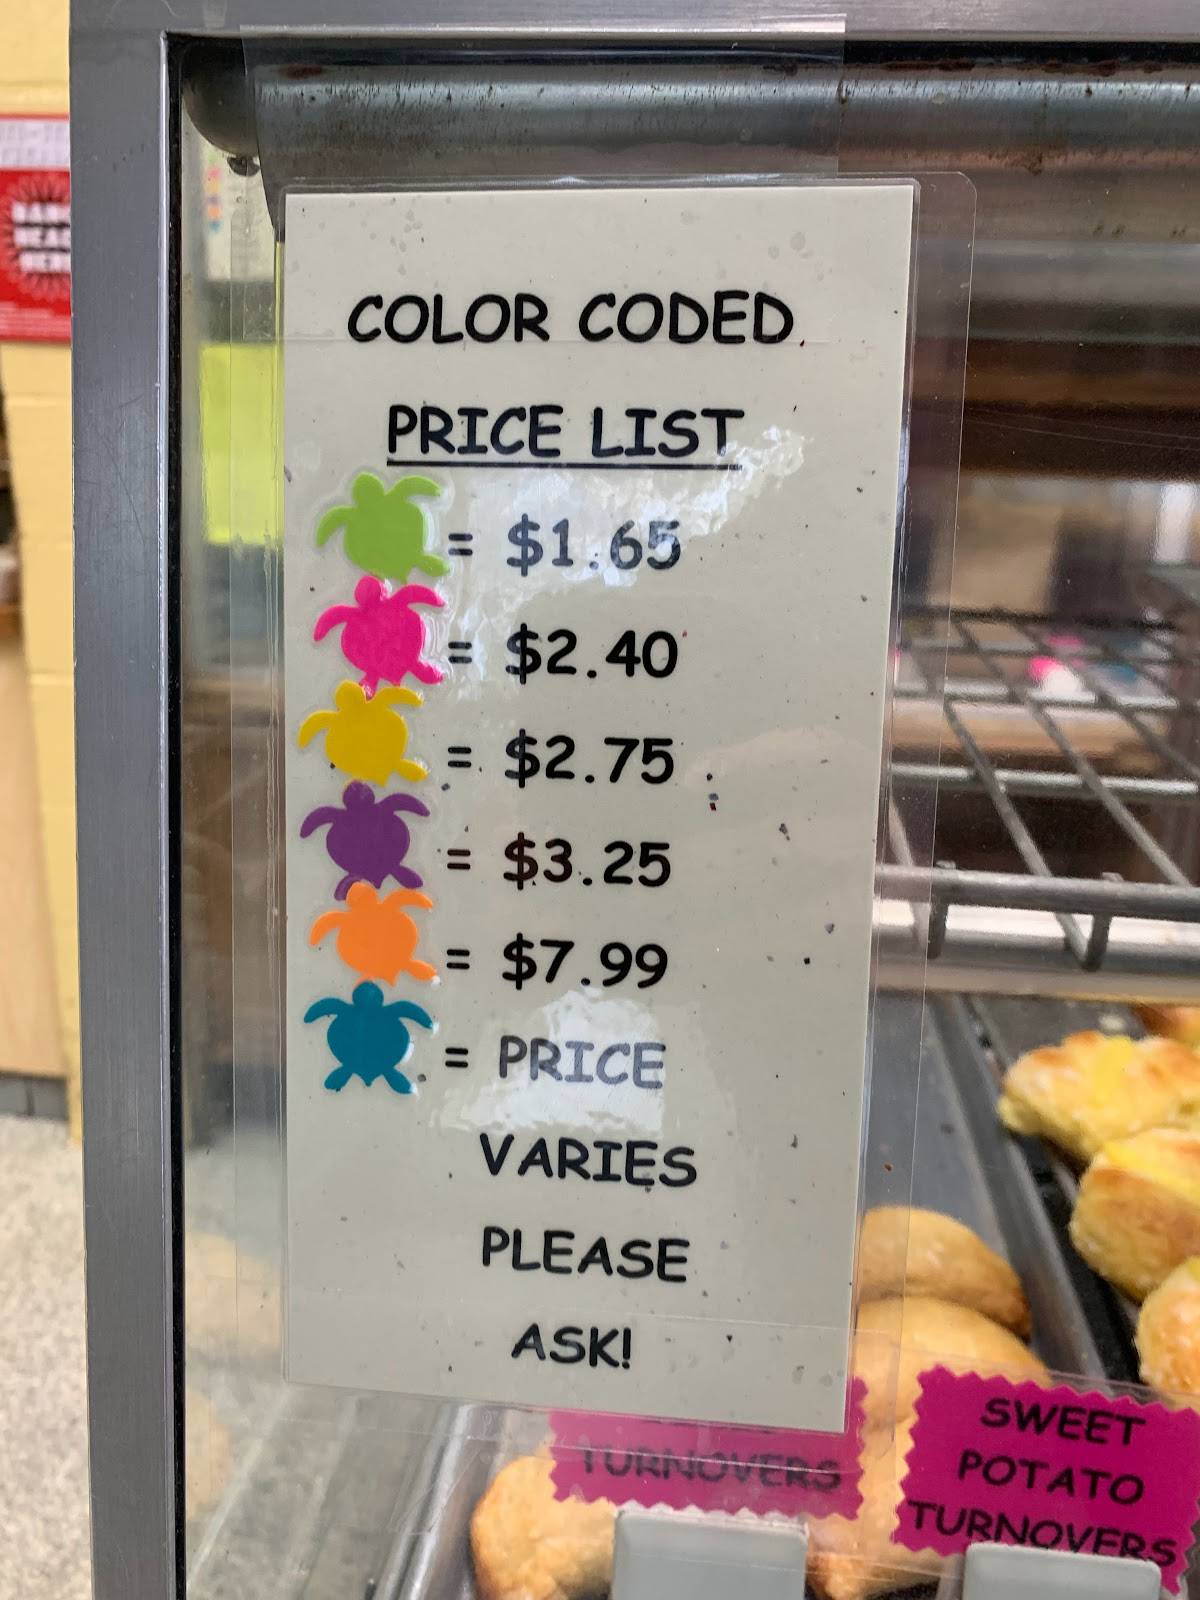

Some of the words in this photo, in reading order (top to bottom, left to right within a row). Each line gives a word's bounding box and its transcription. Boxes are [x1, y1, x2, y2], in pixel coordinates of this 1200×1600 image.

[348, 293, 550, 344] COLOR
[579, 290, 794, 344] CODED
[387, 404, 563, 456] PRICE
[591, 406, 745, 457] LIST
[506, 513, 682, 577] $1.65
[505, 622, 679, 685] $2.40
[504, 728, 675, 788] $2.75
[503, 831, 671, 890] $3.25
[502, 932, 668, 990] $7.99
[499, 1034, 667, 1090] PRICE
[480, 1133, 698, 1188] VARIES
[482, 1226, 691, 1283] PLEASE
[510, 1322, 632, 1369] ASK!
[980, 1397, 1146, 1446] SWEET
[581, 1445, 842, 1493] TURNOVERS
[957, 1449, 1145, 1505] POTATO
[907, 1498, 1178, 1567] TURNOVERS
